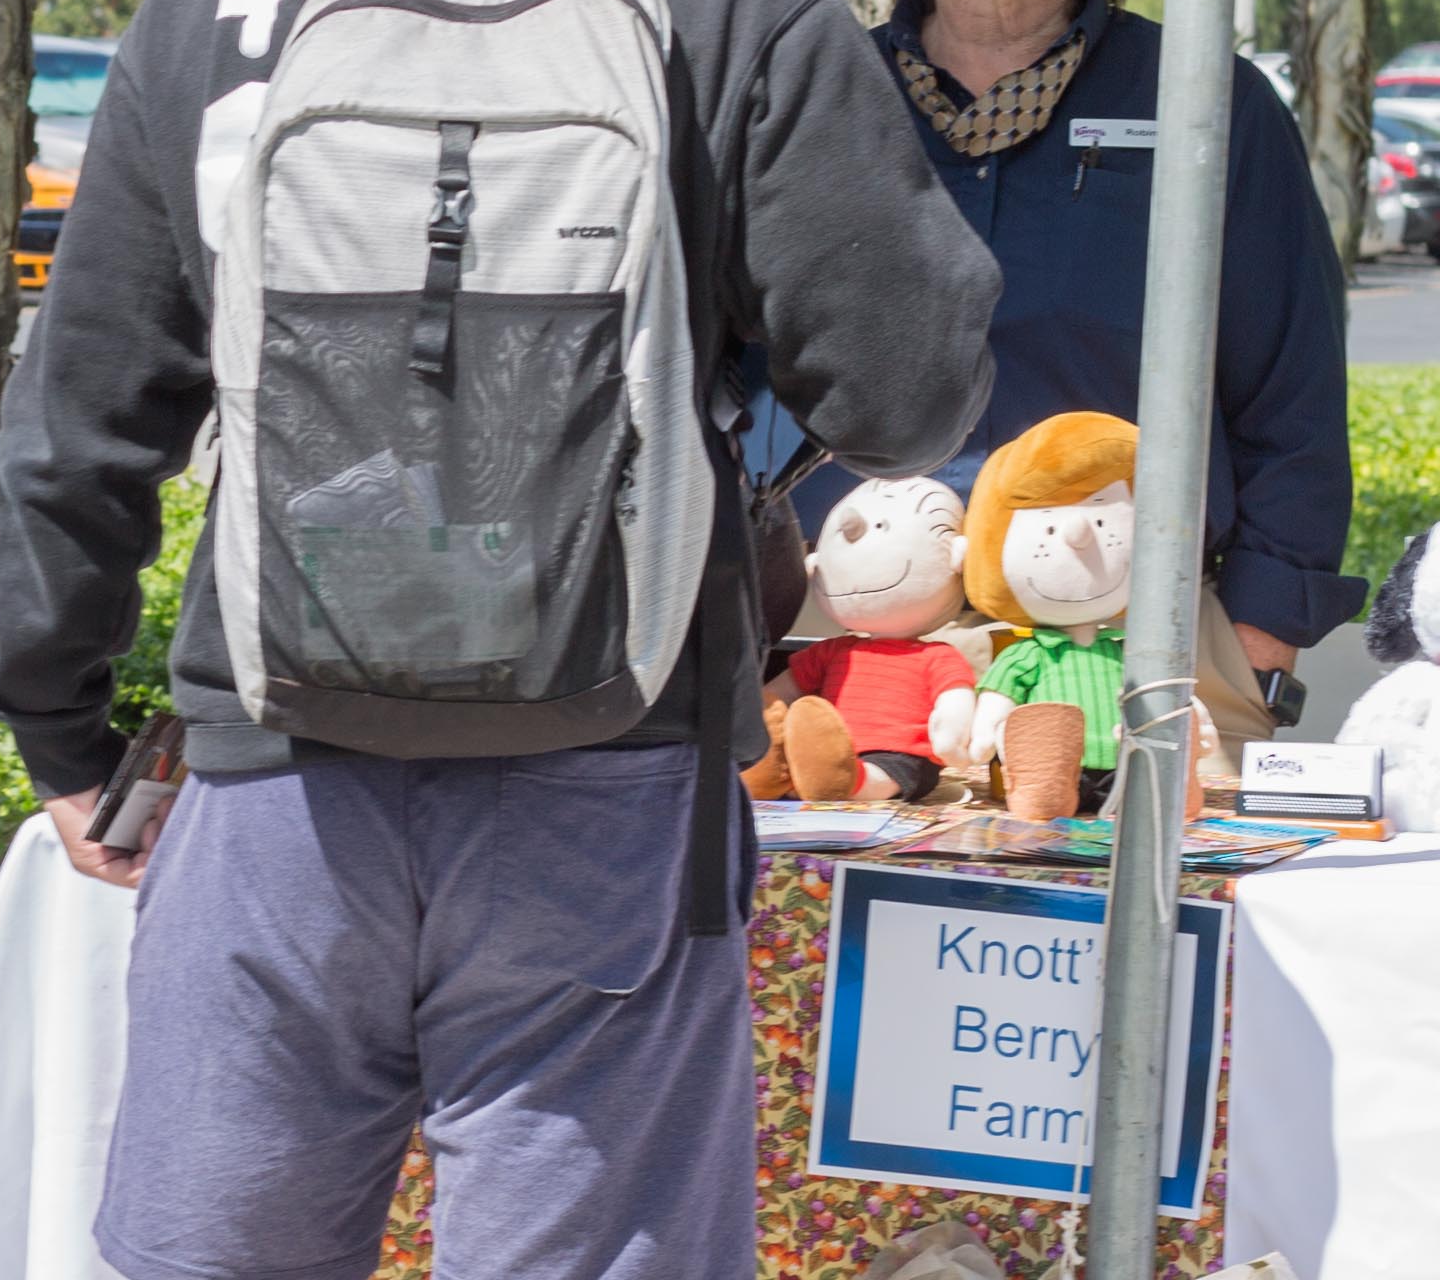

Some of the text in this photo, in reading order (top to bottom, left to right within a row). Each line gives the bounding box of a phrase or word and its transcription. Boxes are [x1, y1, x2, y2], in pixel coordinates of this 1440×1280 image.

[936, 923, 1103, 986] Knott'
[952, 1005, 1103, 1078] Berry
[947, 1084, 1088, 1146] Farm
